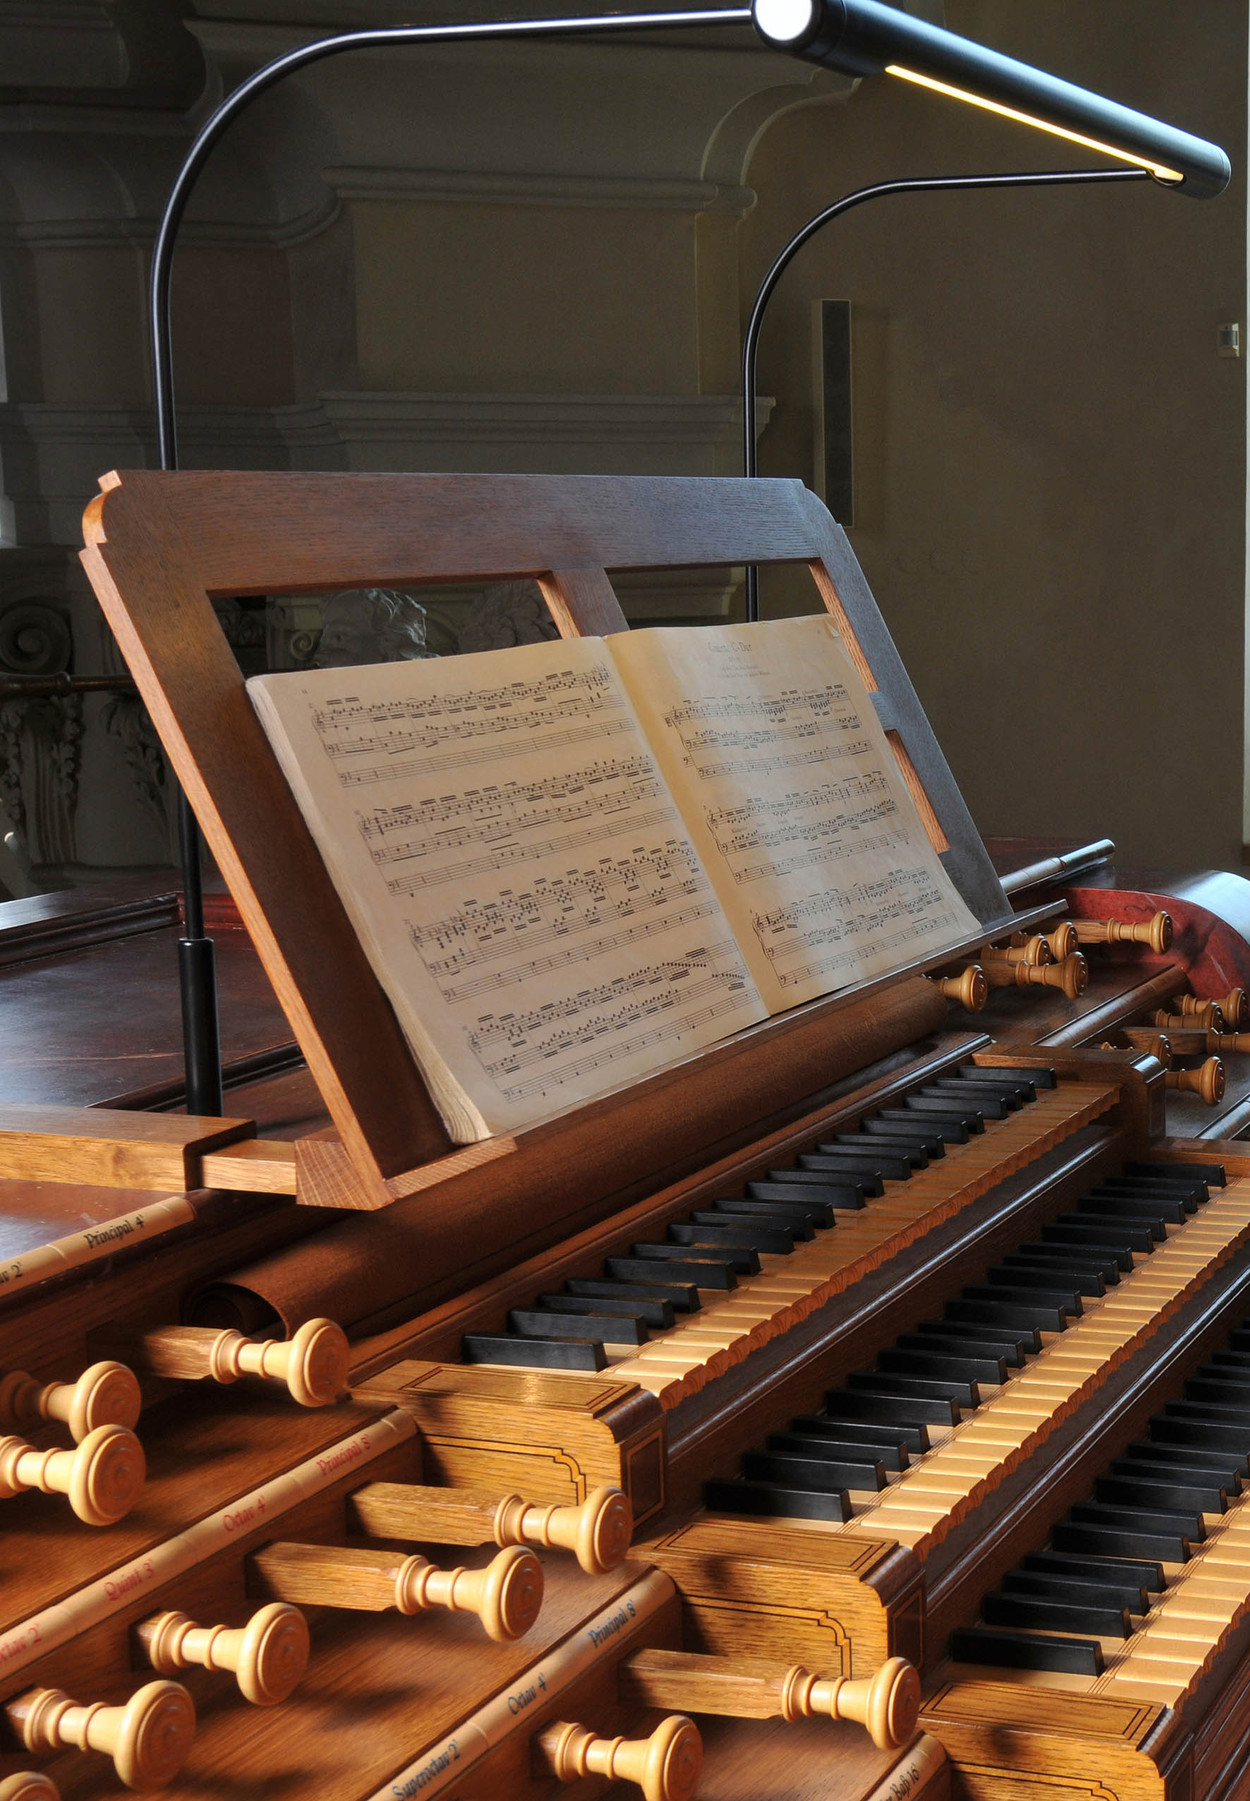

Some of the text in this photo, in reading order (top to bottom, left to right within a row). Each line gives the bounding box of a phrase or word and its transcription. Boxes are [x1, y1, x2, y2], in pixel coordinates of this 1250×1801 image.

[84, 1219, 134, 1249] Principal
[316, 1441, 362, 1476] Principal
[222, 1506, 255, 1532] Octav
[104, 1568, 143, 1601] Quint
[587, 1607, 629, 1649] Principal
[508, 1686, 537, 1716] Octav
[391, 1751, 451, 1801] Superoctav
